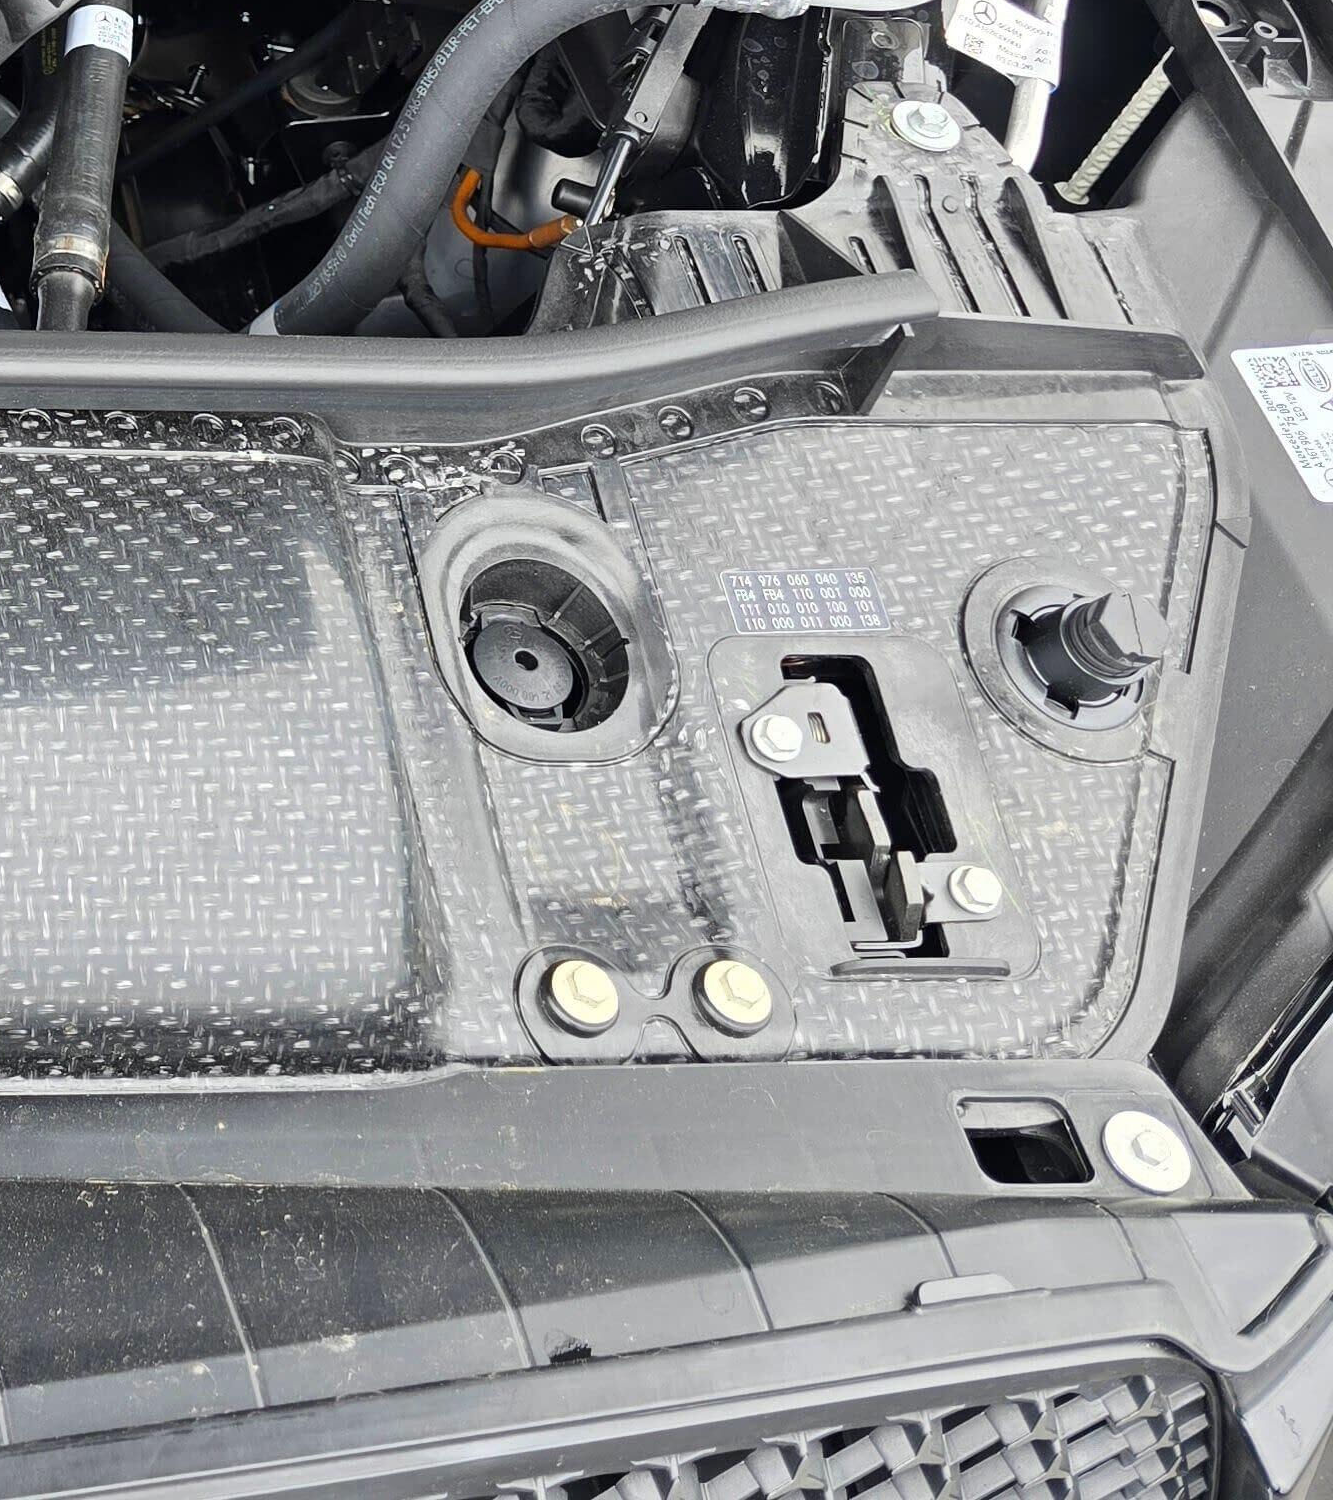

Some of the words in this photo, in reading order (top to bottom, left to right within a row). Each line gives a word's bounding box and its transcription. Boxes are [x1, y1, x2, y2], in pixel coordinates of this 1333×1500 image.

[344, 193, 378, 248] ContiTech
[391, 121, 411, 150] 17,5
[1259, 388, 1277, 412] Benz
[1279, 421, 1313, 469] Mercedes
[729, 575, 753, 587] 714
[758, 574, 781, 587] 976
[786, 573, 809, 586] 060
[815, 572, 838, 585] 040
[844, 571, 866, 584] 135
[734, 589, 756, 602] FB4
[762, 588, 784, 601] FB4
[792, 587, 815, 600] 110
[819, 586, 842, 599] 001
[848, 585, 871, 598] 000
[739, 603, 761, 617] 111
[767, 602, 791, 616] 010
[795, 601, 819, 615] 010
[825, 601, 848, 614] 100
[853, 600, 876, 613] 101
[744, 618, 766, 631] 110
[771, 616, 795, 630] 000
[800, 616, 823, 629] 011
[829, 615, 852, 628] 000
[858, 614, 881, 627] 138
